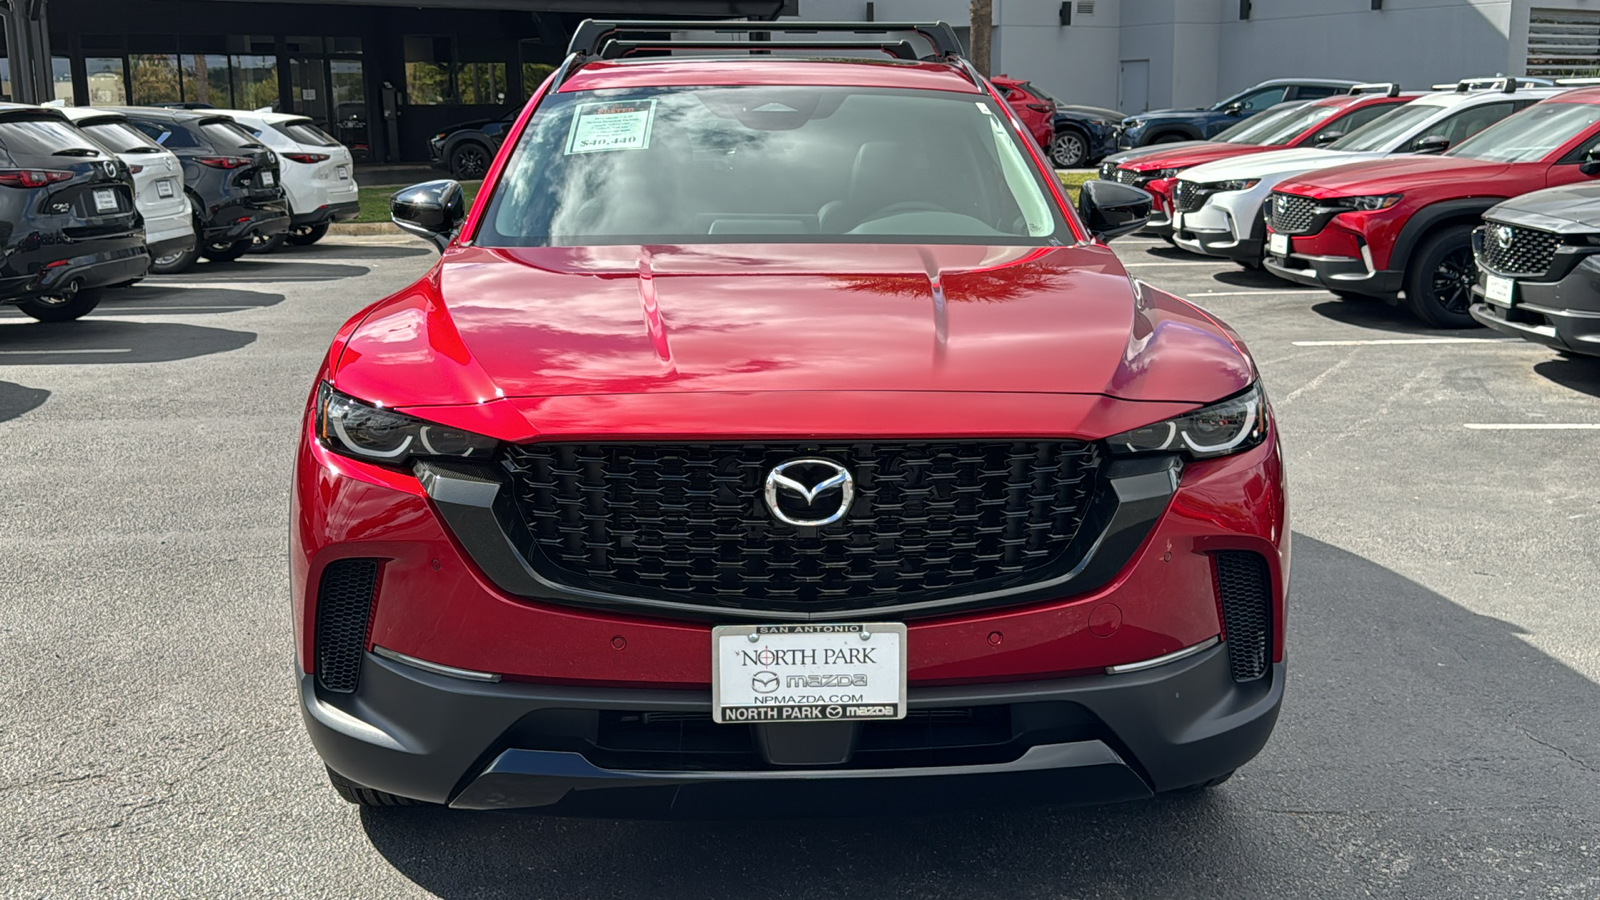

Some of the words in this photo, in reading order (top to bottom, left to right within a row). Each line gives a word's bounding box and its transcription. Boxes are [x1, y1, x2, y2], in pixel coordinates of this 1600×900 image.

[580, 136, 636, 147] $40,440
[759, 626, 790, 634] SAN
[793, 625, 860, 633] ANTONIO
[741, 648, 816, 667] NORTH
[823, 647, 877, 665] PARK
[754, 694, 864, 705] NPMAZDA.COM
[725, 707, 780, 720] NORTH
[782, 705, 823, 719] PARK
